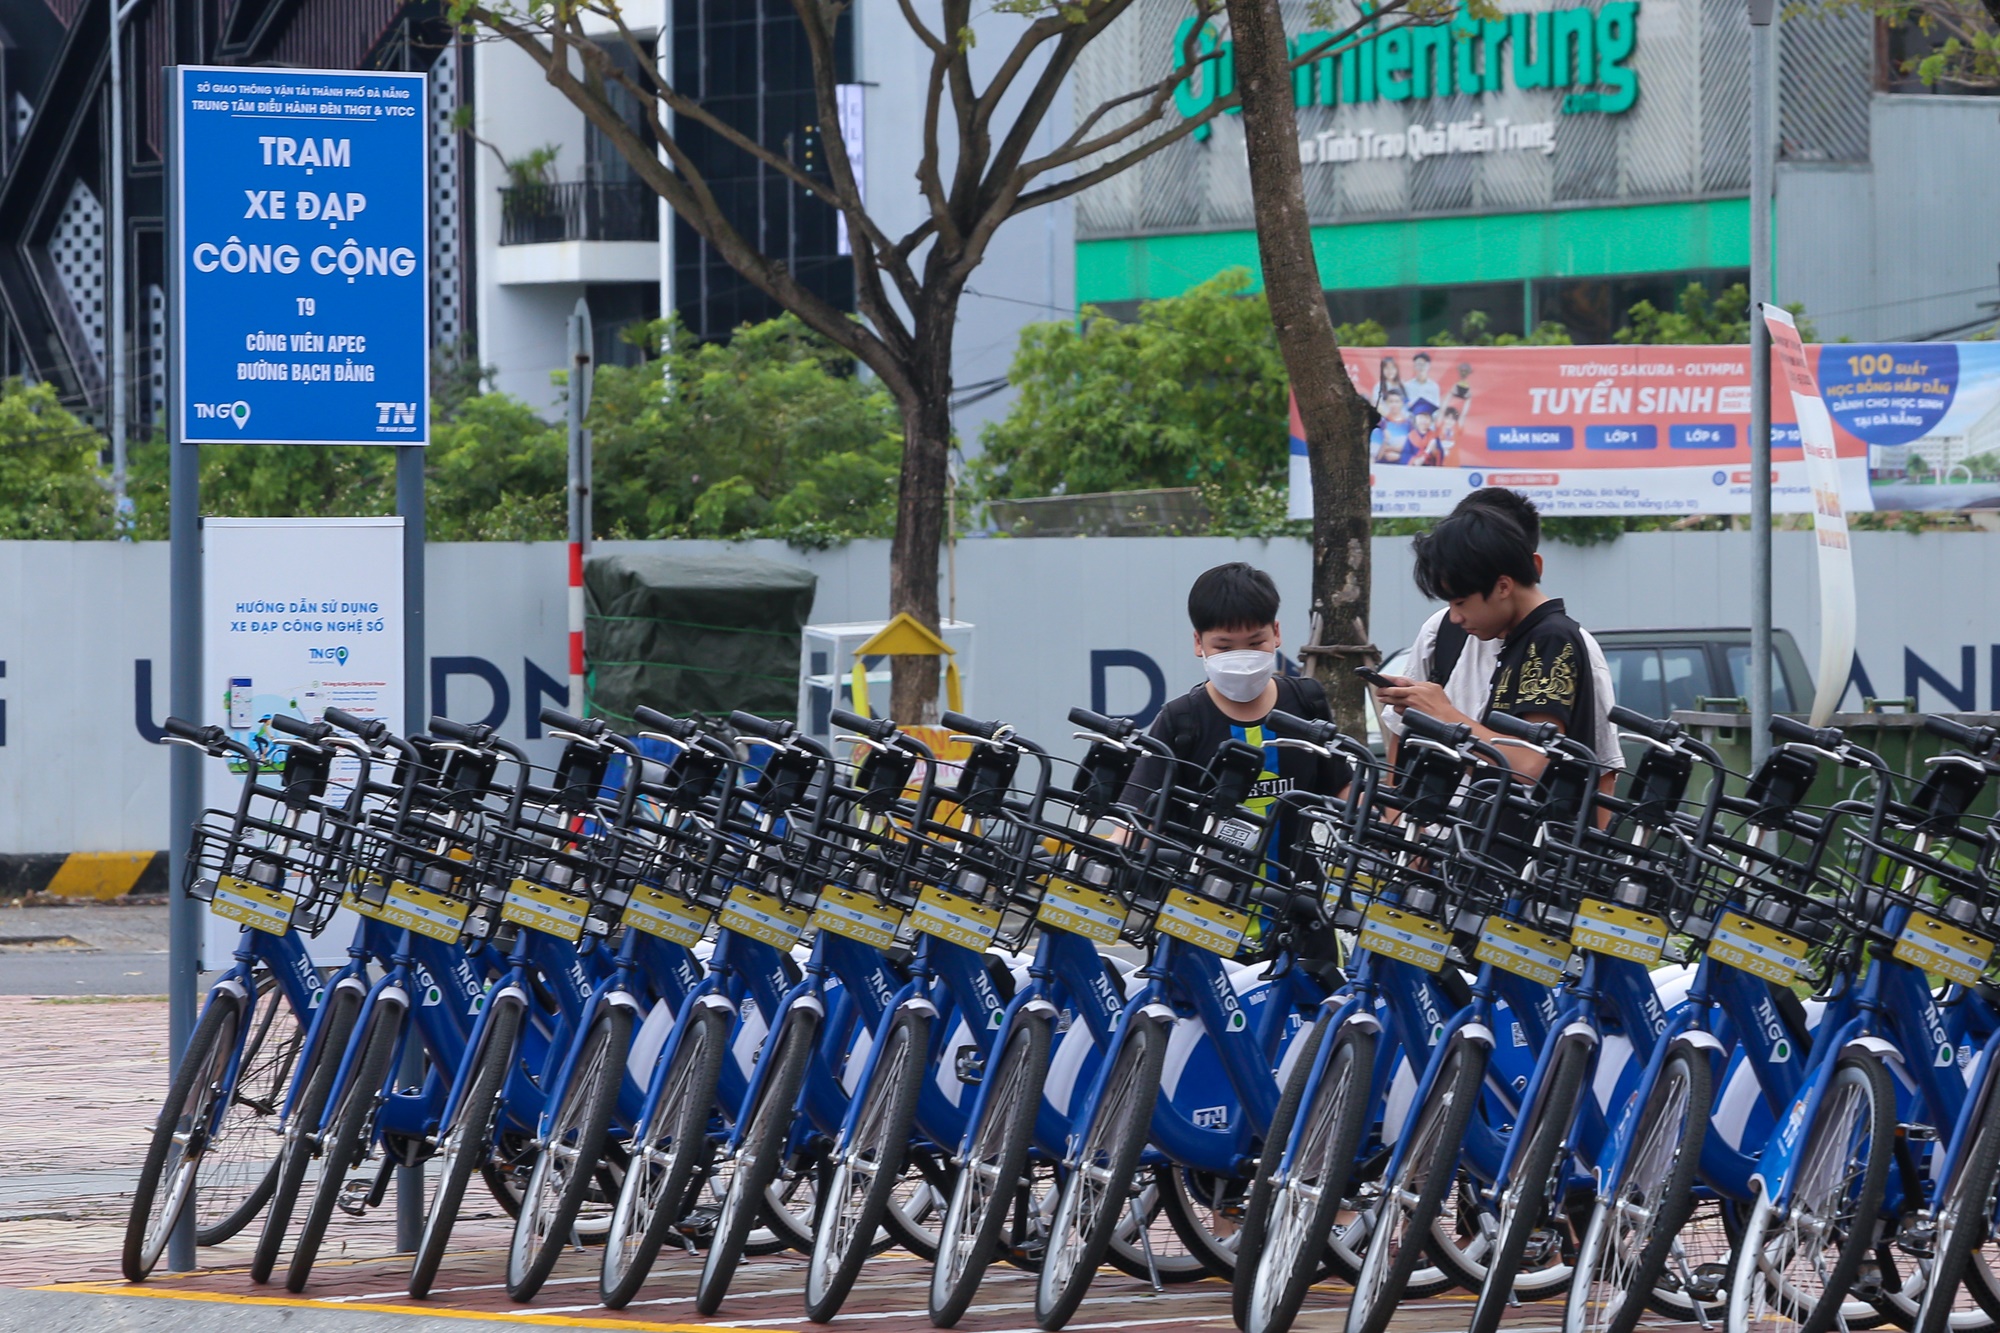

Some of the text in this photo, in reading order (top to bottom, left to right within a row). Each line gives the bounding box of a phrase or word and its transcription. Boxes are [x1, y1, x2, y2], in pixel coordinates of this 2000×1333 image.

[196, 81, 211, 93] SỞ
[212, 84, 237, 93] GIAO
[238, 83, 272, 95] THÔNG
[273, 85, 294, 98] VẬN
[311, 86, 343, 97] THÀNH
[345, 85, 366, 97] PHỐ
[367, 87, 380, 98] ĐÀ
[382, 86, 410, 99] NẴNG
[191, 100, 230, 111] TRUNG
[231, 99, 255, 112] TÂM
[285, 100, 317, 114] HÀNH
[319, 102, 342, 115] ĐÈN
[344, 104, 372, 116] THGT
[374, 106, 383, 116] &
[385, 106, 416, 117] VTCC
[1359, 127, 1406, 160] Trao
[1495, 117, 1557, 155] Trung
[258, 136, 351, 176] TRẠM
[244, 190, 367, 230] XE ĐẠP
[193, 235, 417, 284] CÔNG CỘNG
[296, 297, 316, 317] T9
[246, 330, 367, 354] CÔNG VIÊN APEC
[237, 358, 376, 385] ĐƯỜNG BẠCH ĐẰNG
[1559, 361, 1618, 377] TRƯỜNG
[1621, 364, 1674, 377] SAKURA
[1685, 363, 1744, 377] OLYMPIA
[1848, 354, 1929, 377] 100 SUẤT
[1529, 379, 1634, 415] TUYỂN
[1636, 387, 1714, 414] SINH
[1826, 384, 1855, 398] HỌC
[375, 402, 418, 424] TN
[1833, 398, 1944, 412] DÀNH CHO HỌC SINH
[1854, 411, 1923, 429] TẠI ĐÀ NẴNG
[1532, 432, 1560, 444] NON
[1605, 428, 1638, 443] LỚP 1
[1685, 428, 1720, 443] LỚP 6
[236, 597, 379, 616] HƯỚNG DẪN SỬ DỤNG
[230, 617, 385, 635] XE ĐẠP CÔNG NGHỆ SỐ
[570, 960, 594, 999] TNG
